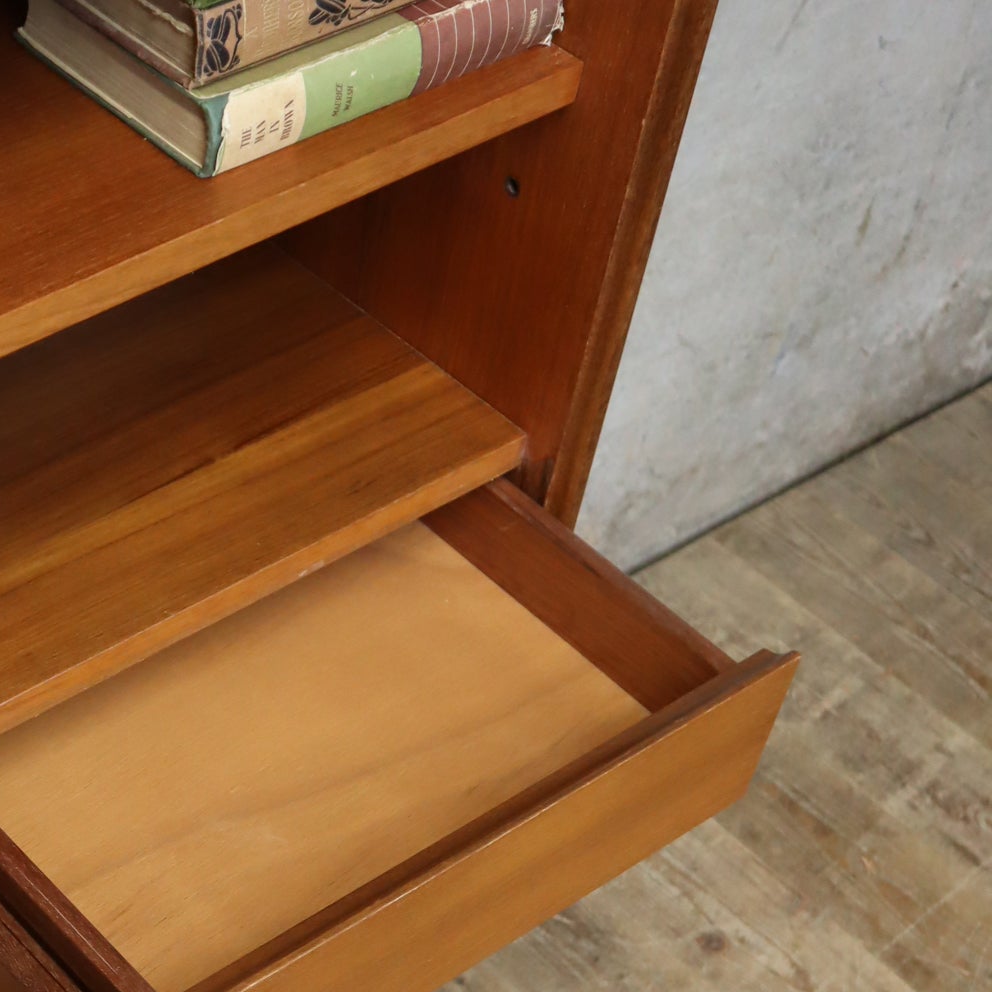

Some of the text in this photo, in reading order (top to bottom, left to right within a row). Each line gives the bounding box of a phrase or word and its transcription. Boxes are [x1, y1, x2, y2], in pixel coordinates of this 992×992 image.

[331, 82, 343, 117] MAURICE
[343, 85, 354, 112] WALSH
[254, 120, 266, 144] MAN
[270, 120, 280, 134] IN
[280, 99, 294, 141] BROWN
[240, 126, 252, 149] THE
